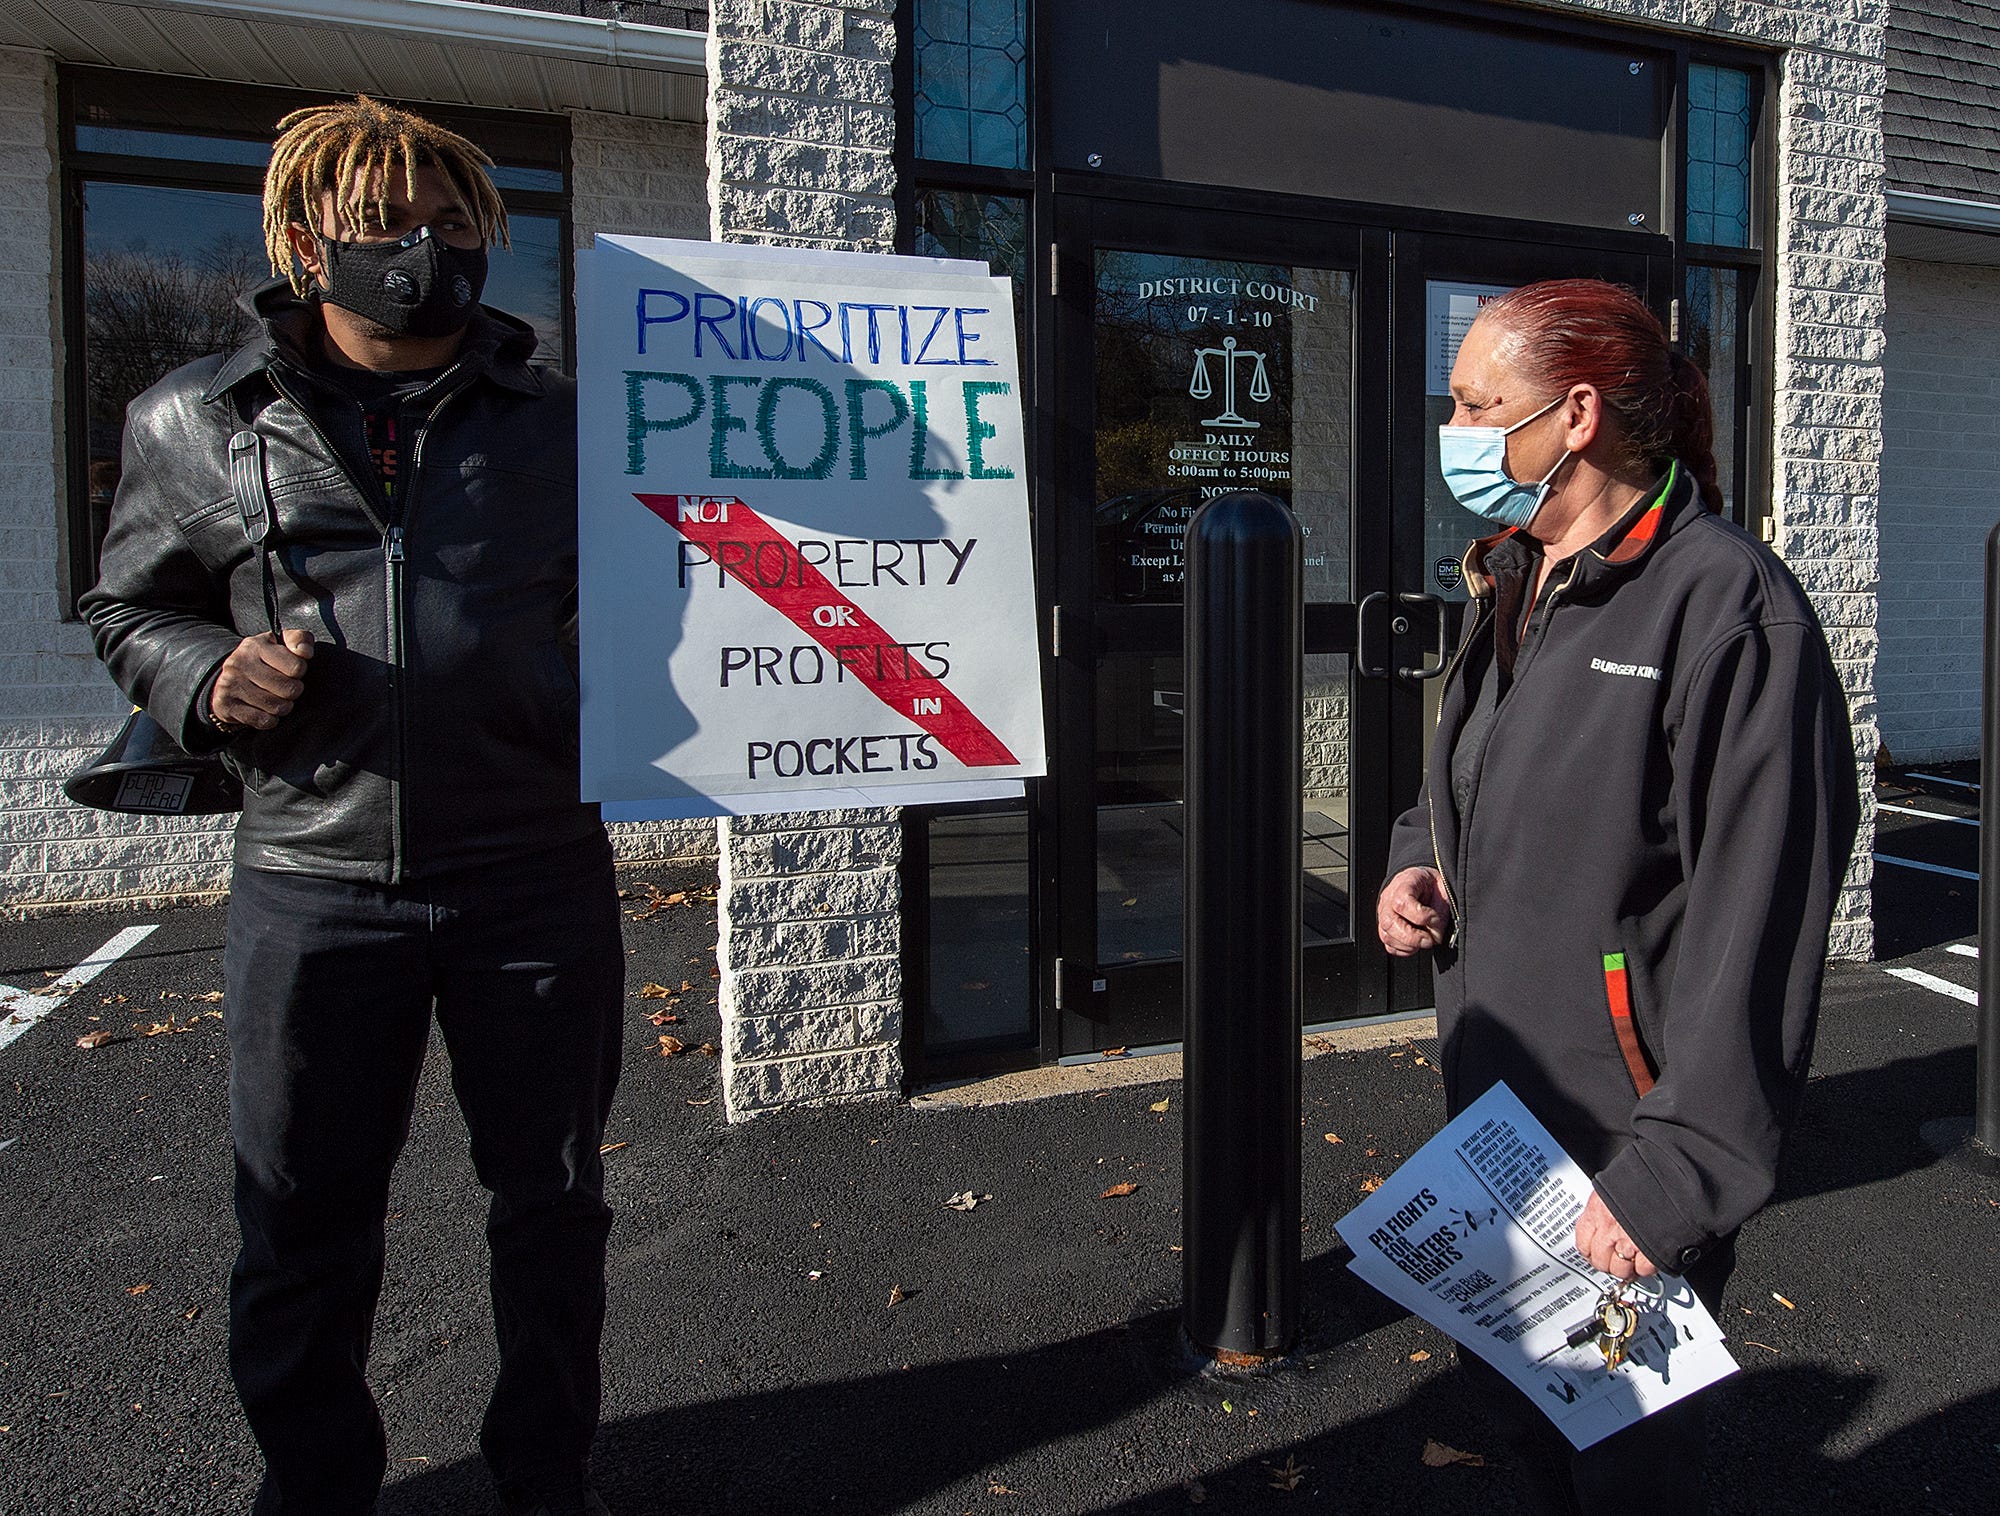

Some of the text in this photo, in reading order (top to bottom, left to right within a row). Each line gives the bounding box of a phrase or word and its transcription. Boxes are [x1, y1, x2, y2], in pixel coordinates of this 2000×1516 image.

[1138, 277, 1319, 313] DISTRICT COURT
[636, 288, 999, 366] PRIORITIZE
[623, 370, 1015, 481] PEOPLE
[1204, 433, 1256, 447] DAILY
[1168, 448, 1290, 463] OFFICE HOURS
[1167, 464, 1291, 481] 8:00am to 5:00pm
[676, 495, 736, 524] NOT
[1161, 506, 1178, 518] No
[1144, 522, 1187, 534] Permitt
[677, 538, 978, 589] PROPERTY
[1131, 554, 1170, 569] Except
[1438, 565, 1460, 573] DM2
[1162, 572, 1175, 582] as
[812, 604, 861, 628] OR
[719, 640, 951, 689] PROFITS
[1590, 657, 1638, 677] BURGER
[912, 696, 943, 716] IN
[748, 732, 938, 780] POCKETS
[1367, 1187, 1439, 1250] PA FIGHTS
[1381, 1234, 1414, 1263] FOR
[1395, 1223, 1457, 1276] RENTERS
[1409, 1244, 1464, 1287] RIGHTS
[1458, 1268, 1485, 1286] BUCKS
[1453, 1274, 1497, 1301] CHANGE
